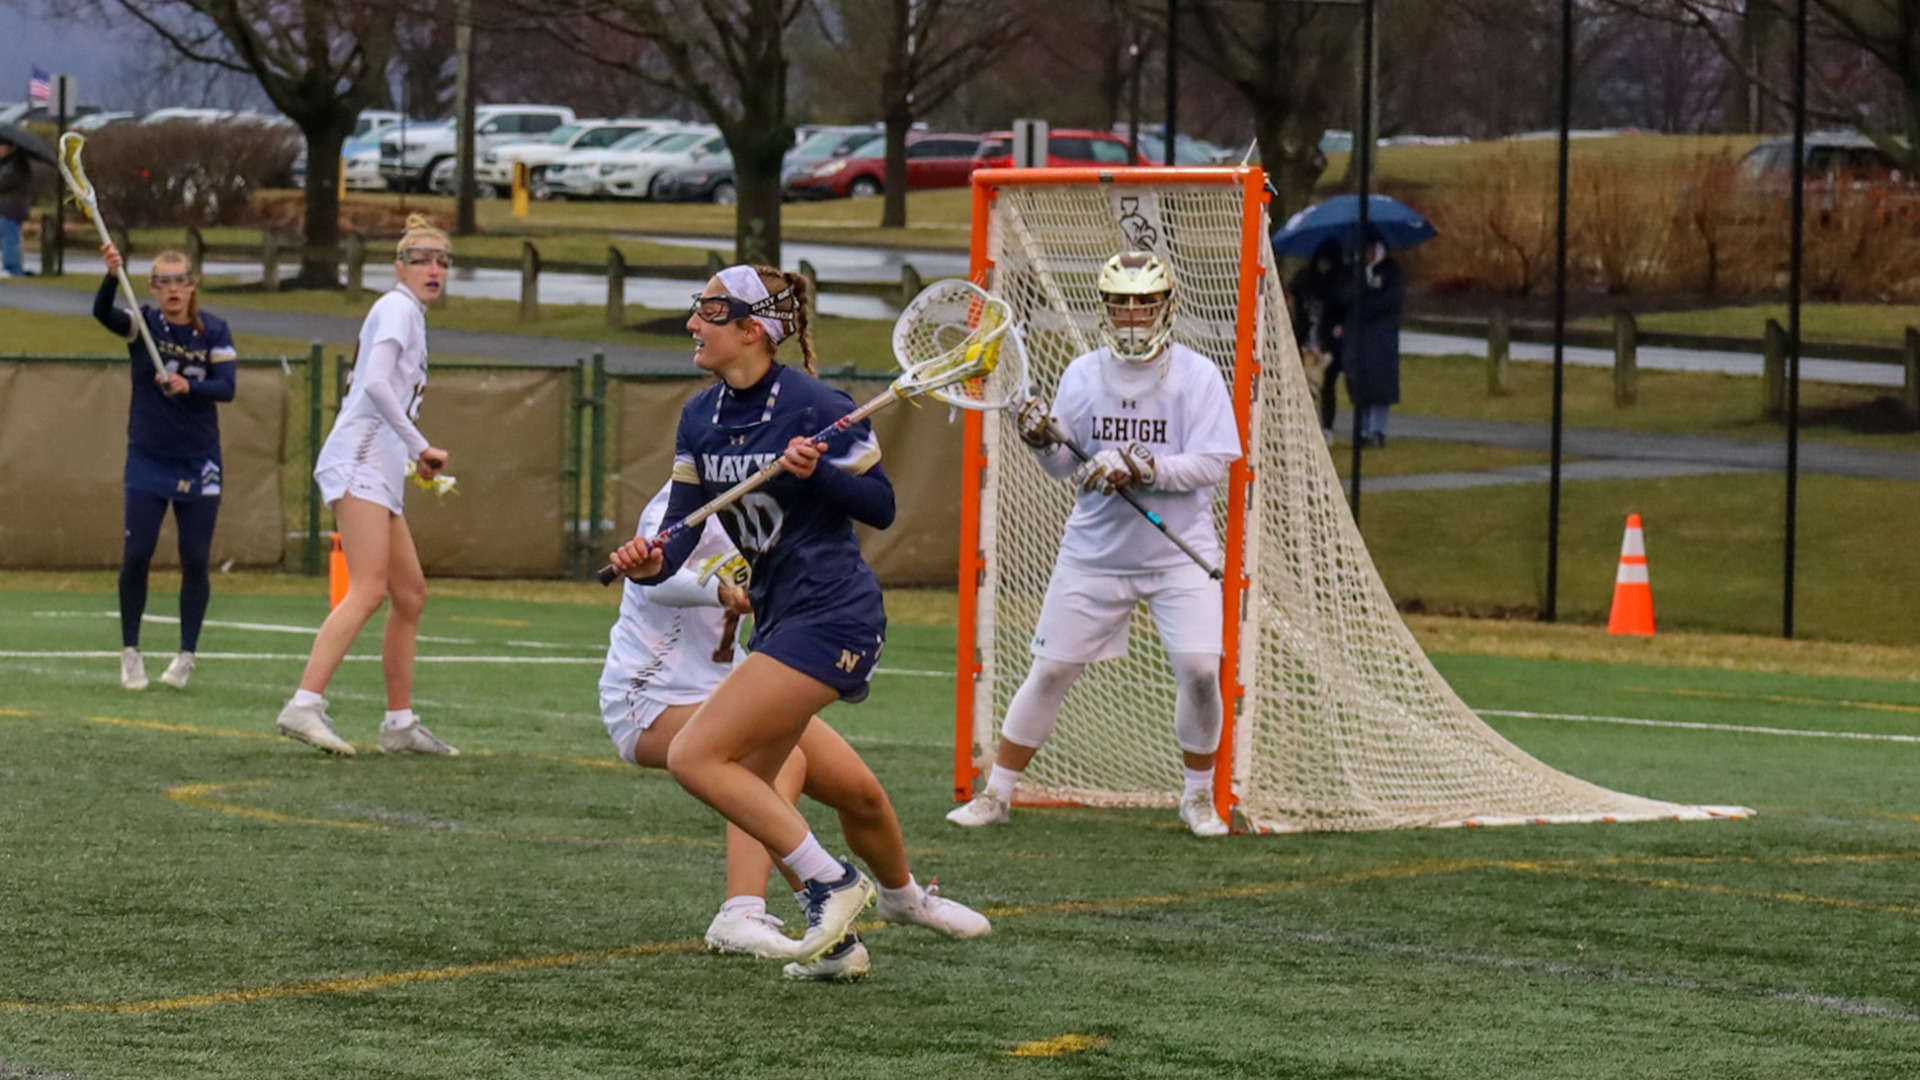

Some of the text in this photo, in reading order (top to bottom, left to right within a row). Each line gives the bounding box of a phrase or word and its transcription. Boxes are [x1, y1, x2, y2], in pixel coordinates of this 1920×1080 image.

[1092, 416, 1167, 444] LEHIGH
[702, 452, 777, 482] NAVY
[835, 648, 861, 673] N
